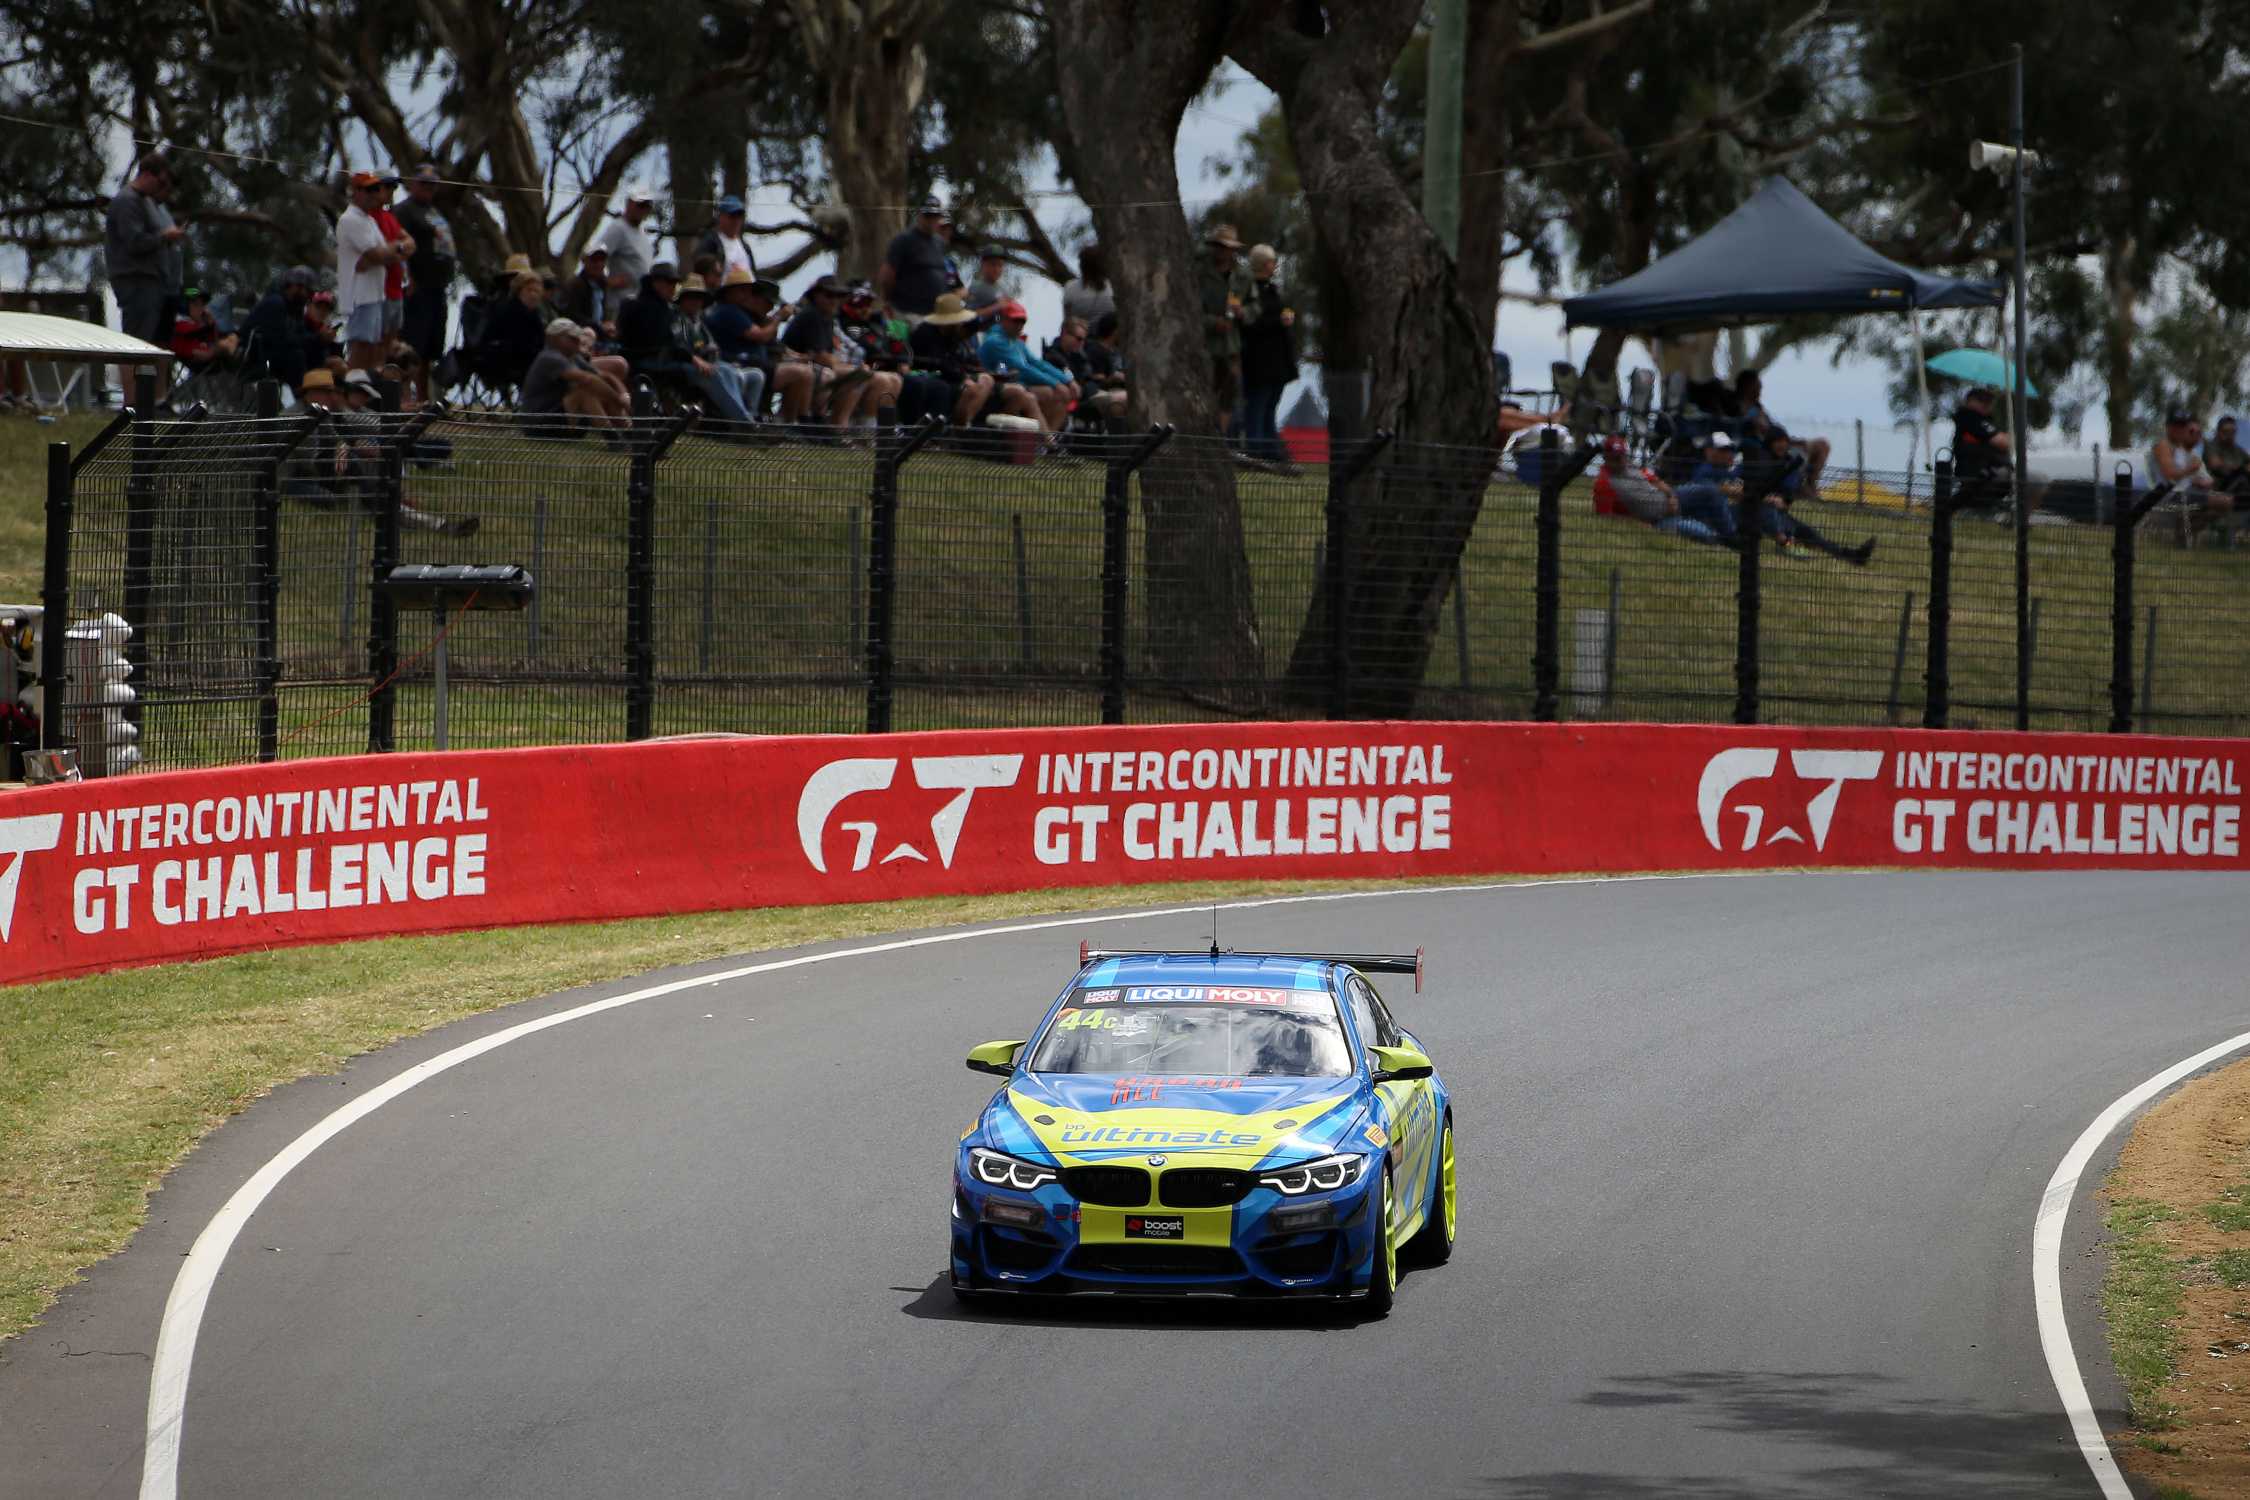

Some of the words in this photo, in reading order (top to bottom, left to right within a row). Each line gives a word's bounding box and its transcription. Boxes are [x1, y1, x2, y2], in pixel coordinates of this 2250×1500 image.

[1038, 745, 1453, 794] INTERCONTINENTAL
[1896, 752, 2241, 795] INTERCONTINENTAL
[76, 778, 489, 856] INTERCONTINENTAL
[1034, 804, 1109, 864] GT
[1124, 795, 1451, 860] CHALLENGE
[1893, 799, 1956, 853] GT
[1967, 800, 2241, 856] CHALLENGE
[74, 864, 140, 933] GT
[153, 834, 488, 926] CHALLENGE
[1130, 988, 1204, 1001] LIQUI
[1208, 988, 1284, 1003] MOLY
[1061, 1127, 1262, 1146] ultimate
[1145, 1219, 1182, 1231] boost
